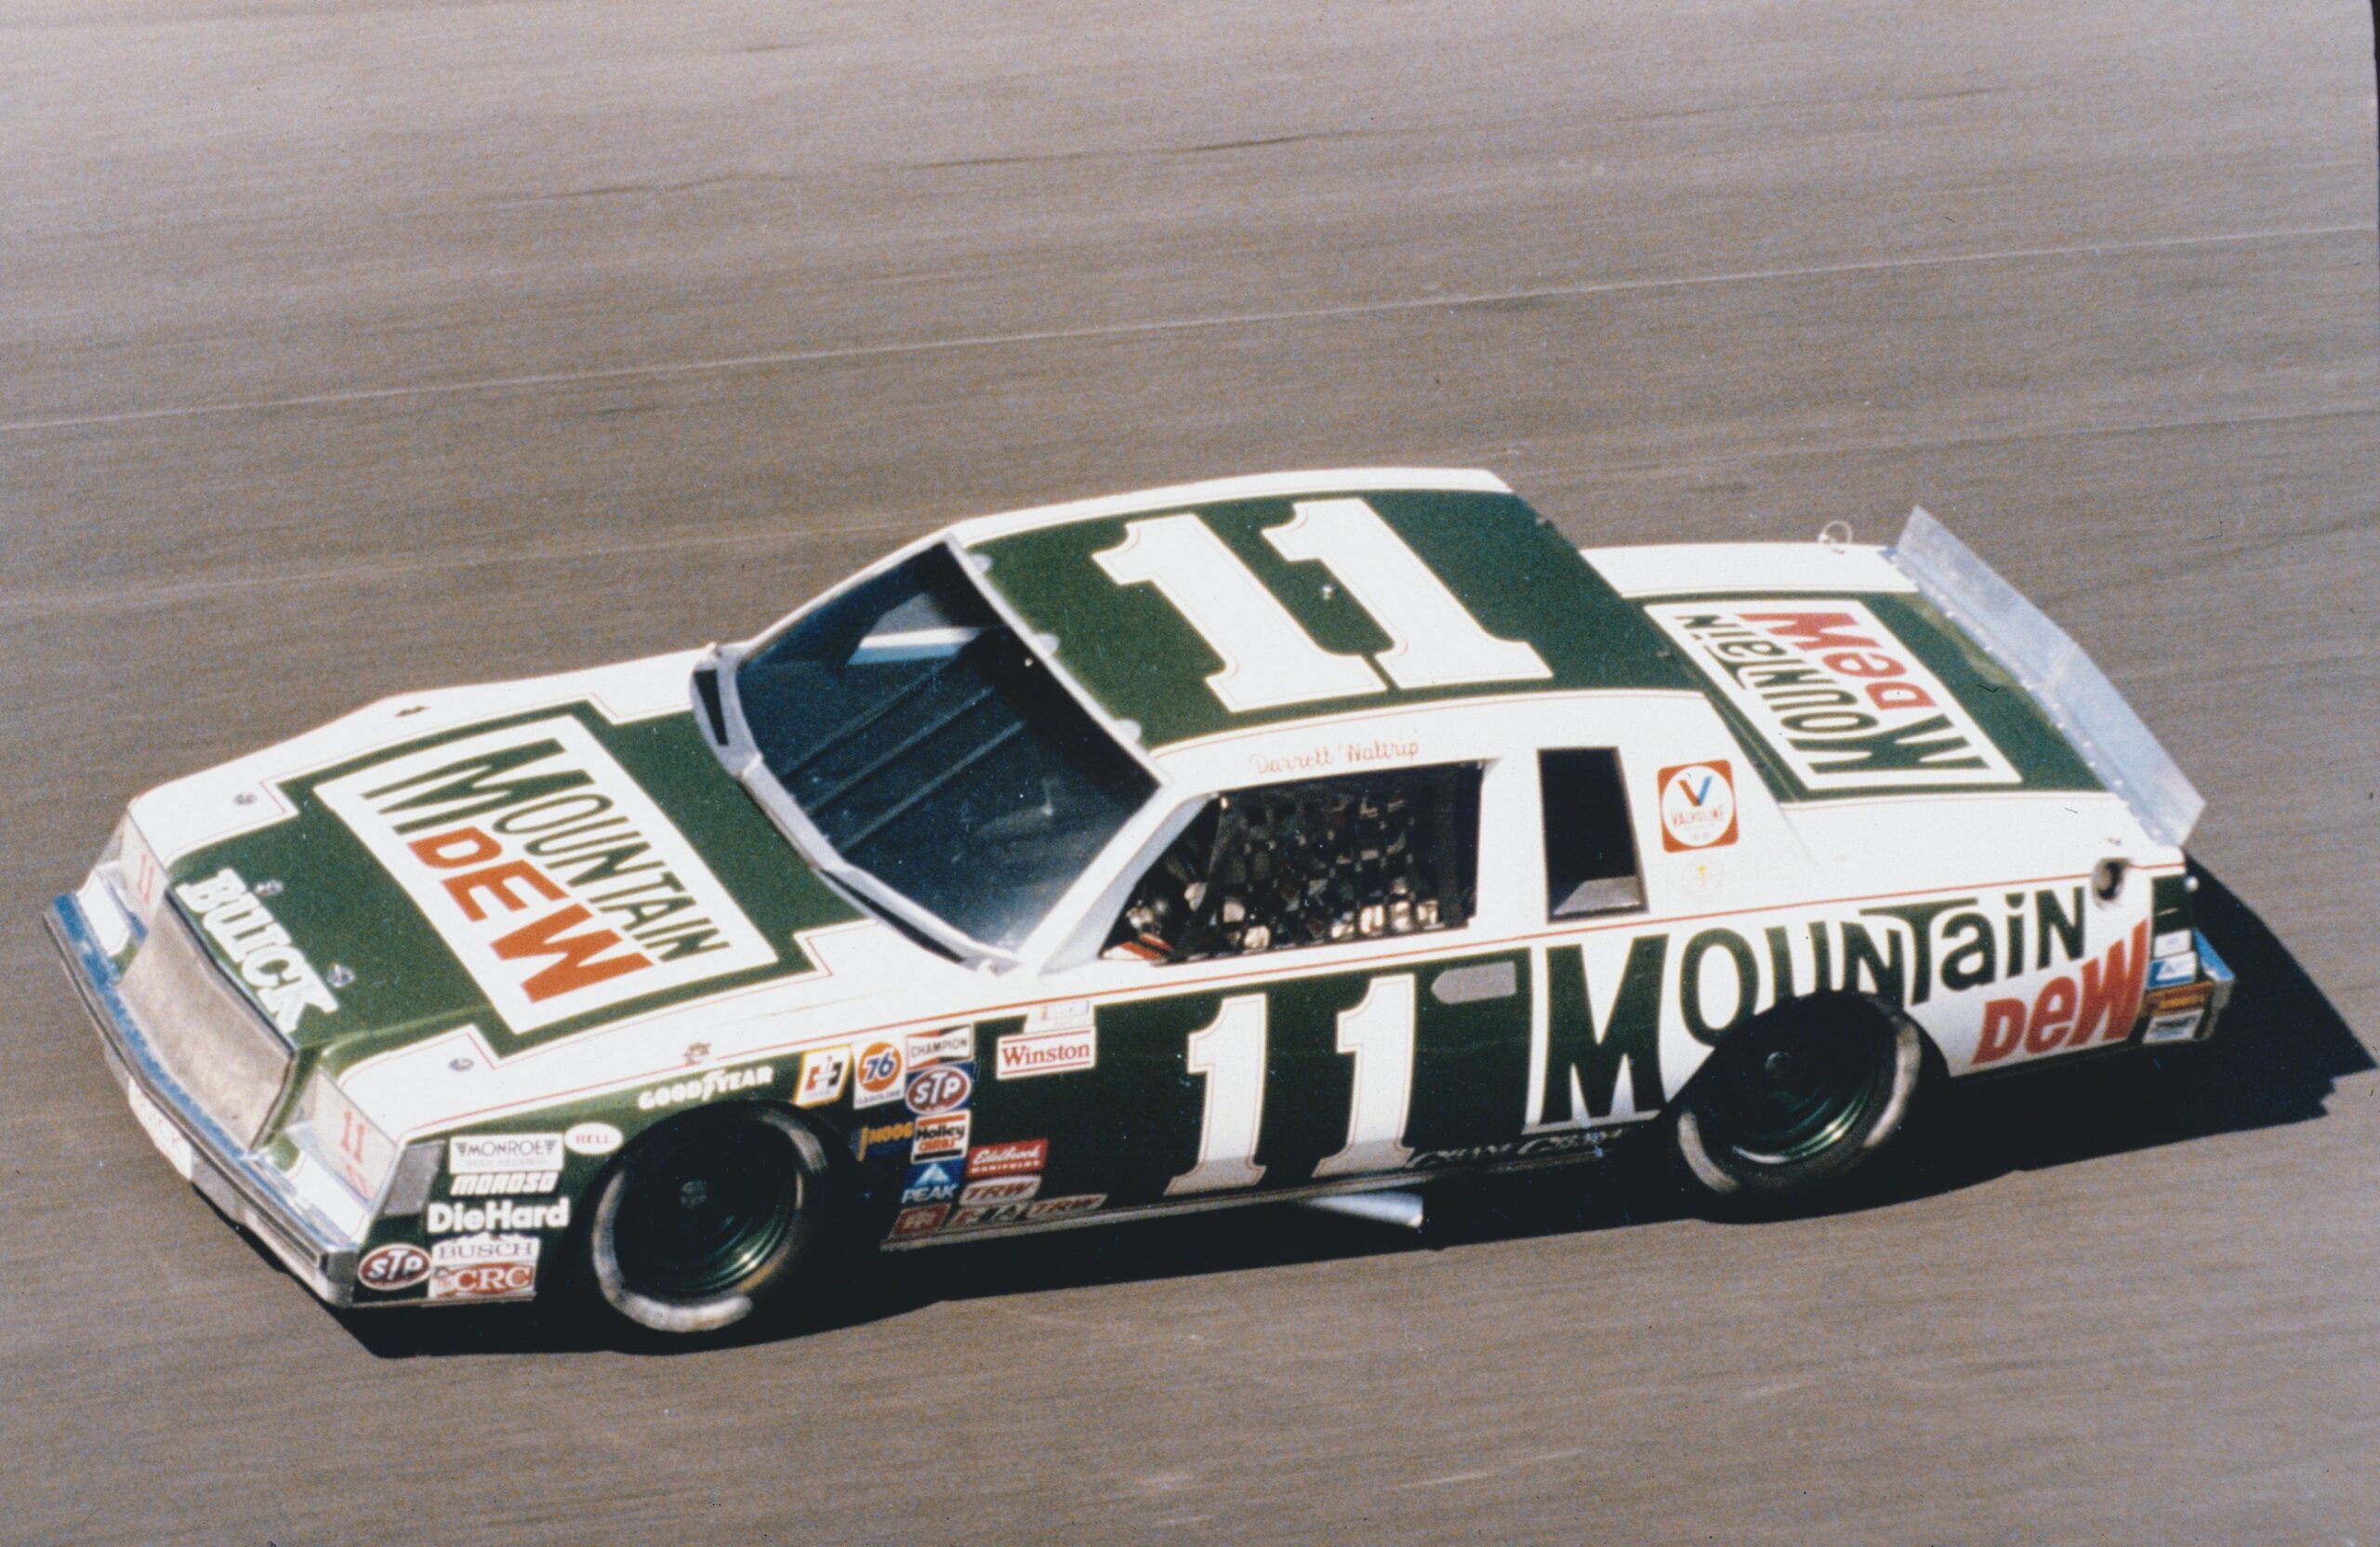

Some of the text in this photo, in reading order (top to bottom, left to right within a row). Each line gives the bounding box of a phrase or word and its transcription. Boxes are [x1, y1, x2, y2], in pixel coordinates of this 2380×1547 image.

[1091, 497, 1553, 712] 11
[362, 737, 731, 963] MOUNTAIN
[409, 826, 654, 1005] DEW
[176, 866, 339, 1033] BUICK
[911, 1038, 968, 1058] CHAMPION
[1002, 1044, 1090, 1066] Winston
[863, 1051, 897, 1083] 76
[638, 1065, 774, 1110] GOODYEAR
[914, 1072, 962, 1104] STP
[1164, 972, 1416, 1197] 11
[341, 1110, 365, 1164] 11
[575, 1134, 611, 1144] BELL
[917, 1124, 965, 1140] Holley
[469, 1140, 545, 1157] MONROE
[974, 1145, 1041, 1165] Edelbrock
[450, 1171, 558, 1196] MOROSO
[902, 1183, 959, 1204] PEAK
[428, 1196, 570, 1234] DieHard
[368, 1250, 424, 1280] STP
[440, 1242, 533, 1260] BUSCH
[455, 1266, 532, 1291] CRC
